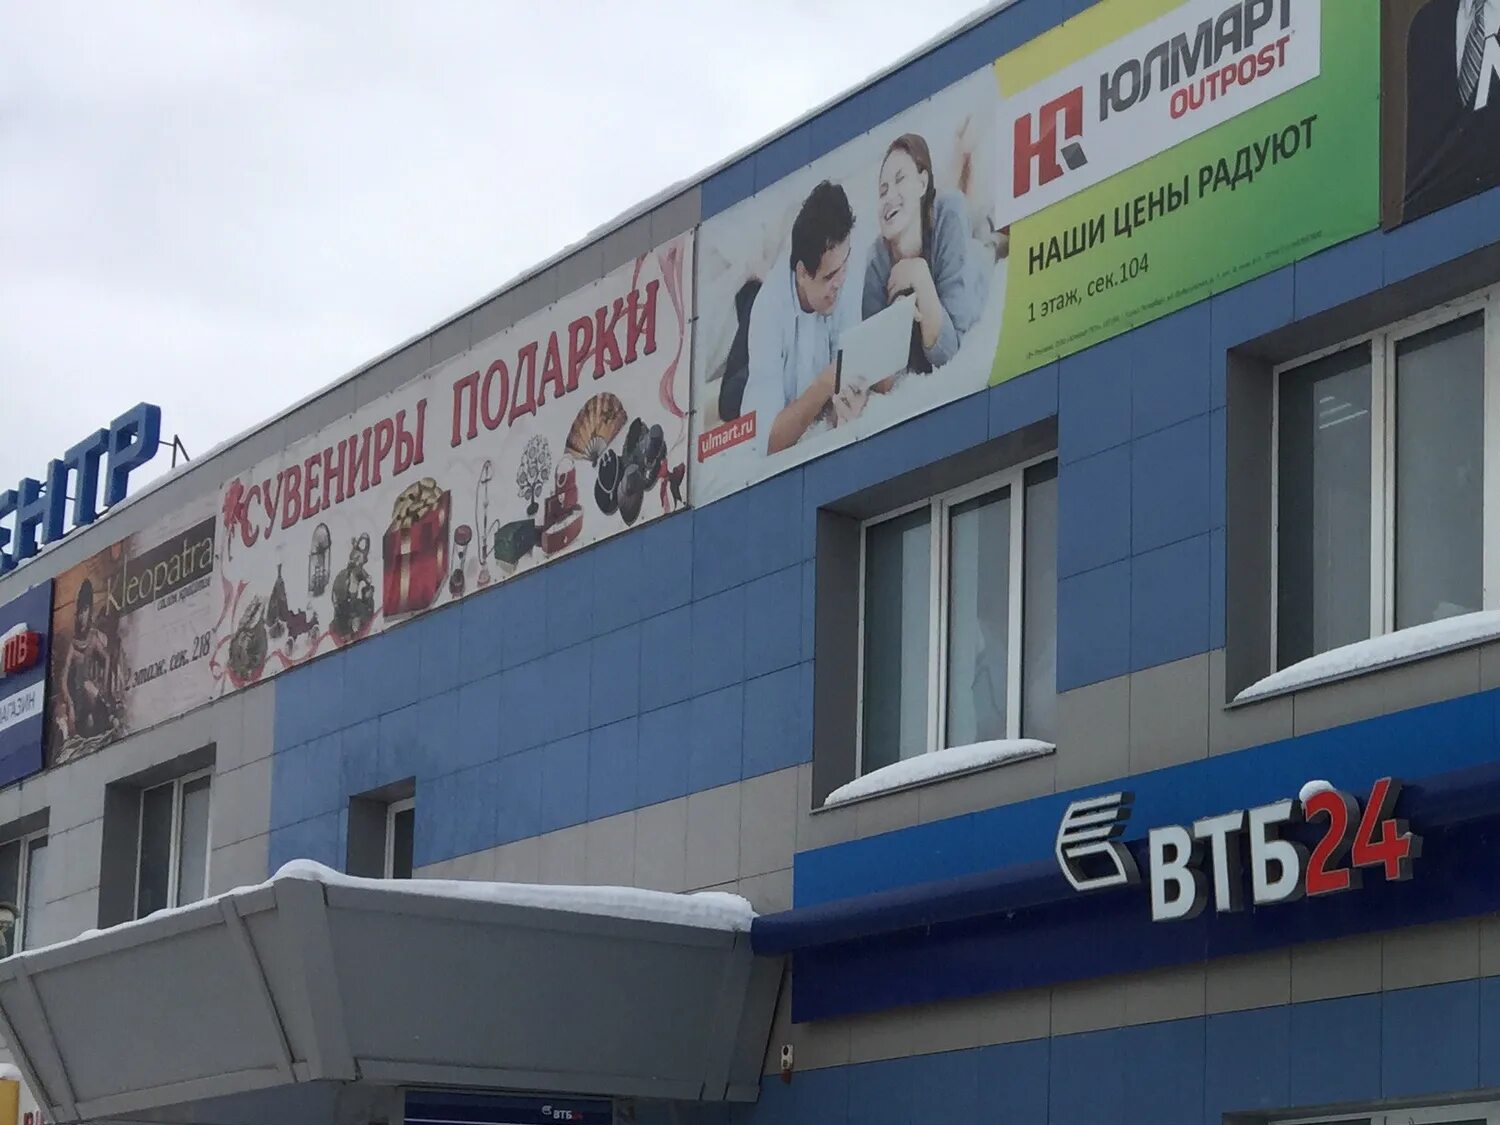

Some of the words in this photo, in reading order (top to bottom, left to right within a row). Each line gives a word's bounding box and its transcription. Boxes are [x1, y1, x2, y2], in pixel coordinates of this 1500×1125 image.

[1099, 0, 1291, 122] ЮЛМАРТ
[1170, 36, 1290, 120] OUTPOST
[1028, 214, 1105, 275] НАШИ
[1113, 175, 1190, 238] ЦЕНЫ
[1199, 114, 1319, 199] РАДУЮТ
[1028, 302, 1036, 323] 1
[1040, 288, 1082, 317] этаж,
[1087, 252, 1149, 297] сек.104
[236, 398, 428, 548] СУВЕНИРЫ
[450, 279, 660, 448] ПОДАРКИ
[702, 419, 753, 453] ulmart.ru
[105, 537, 213, 616] Kleopatra
[1148, 776, 1414, 922] ВТБ24
